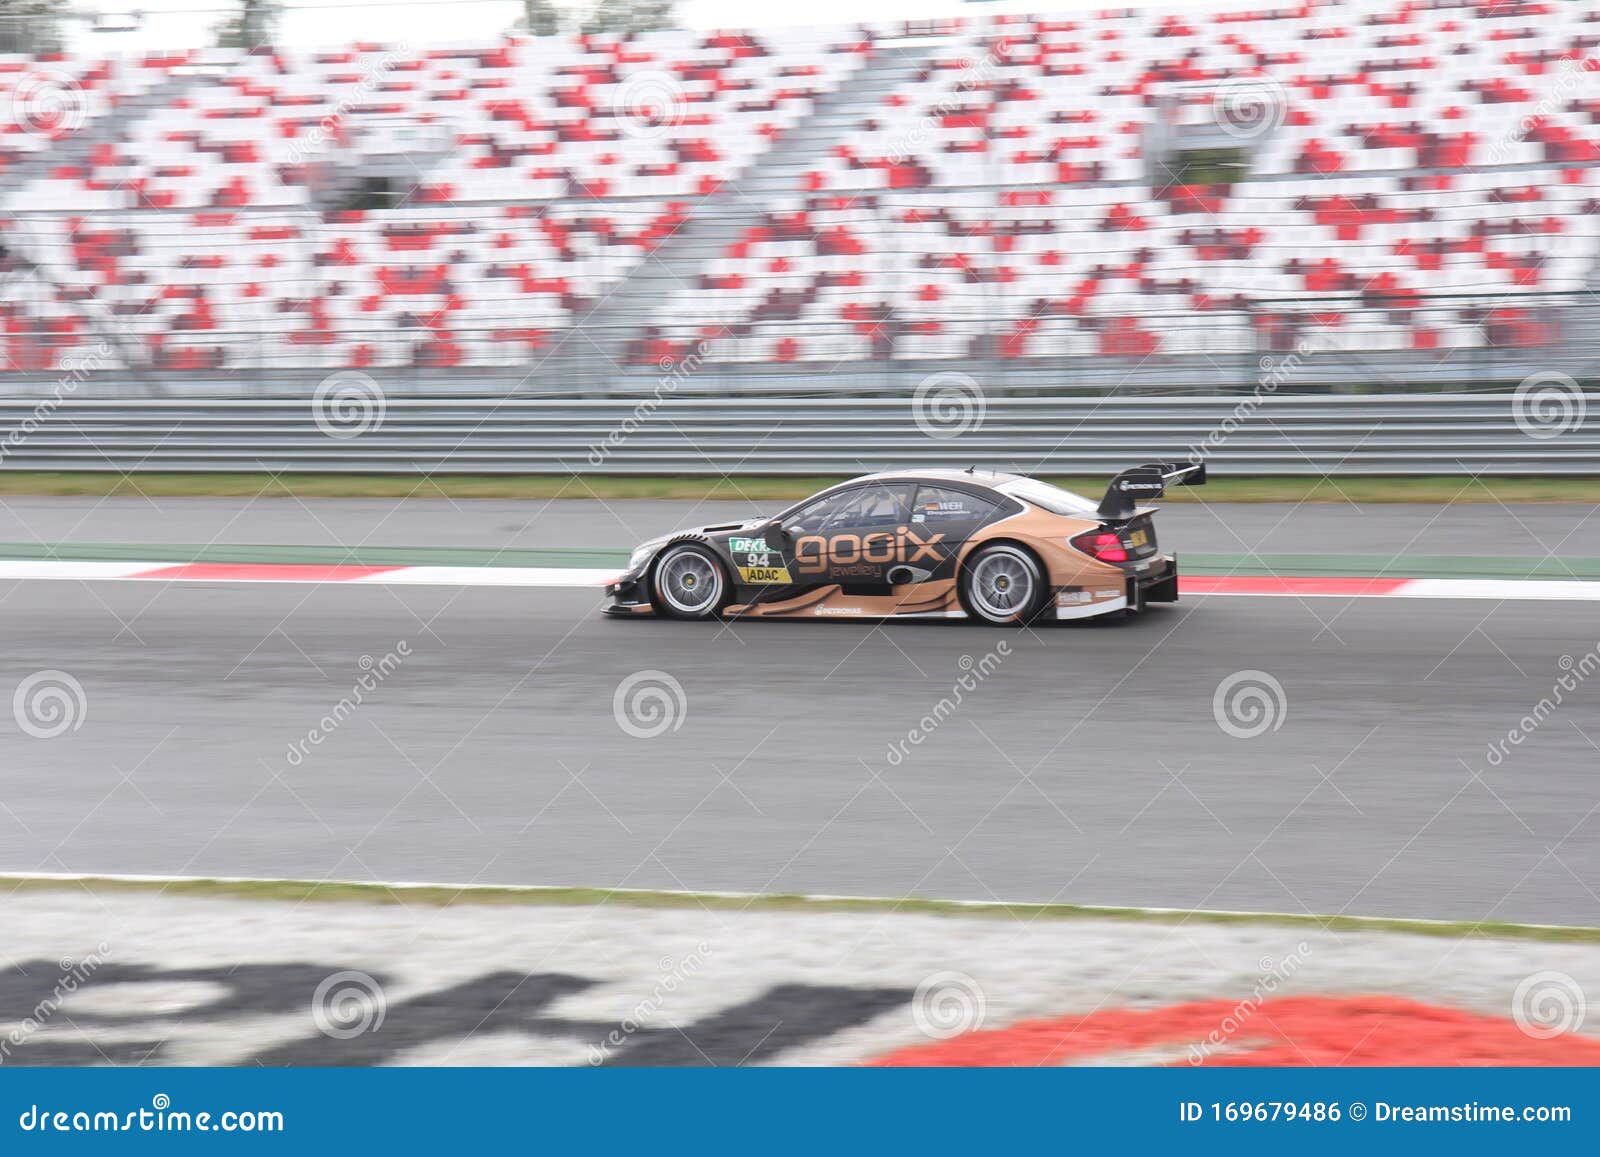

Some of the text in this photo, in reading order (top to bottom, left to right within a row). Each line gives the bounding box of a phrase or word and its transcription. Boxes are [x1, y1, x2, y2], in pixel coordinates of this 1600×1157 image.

[795, 526, 945, 573] gooix
[747, 553, 770, 567] 94
[749, 569, 779, 581] ADAC
